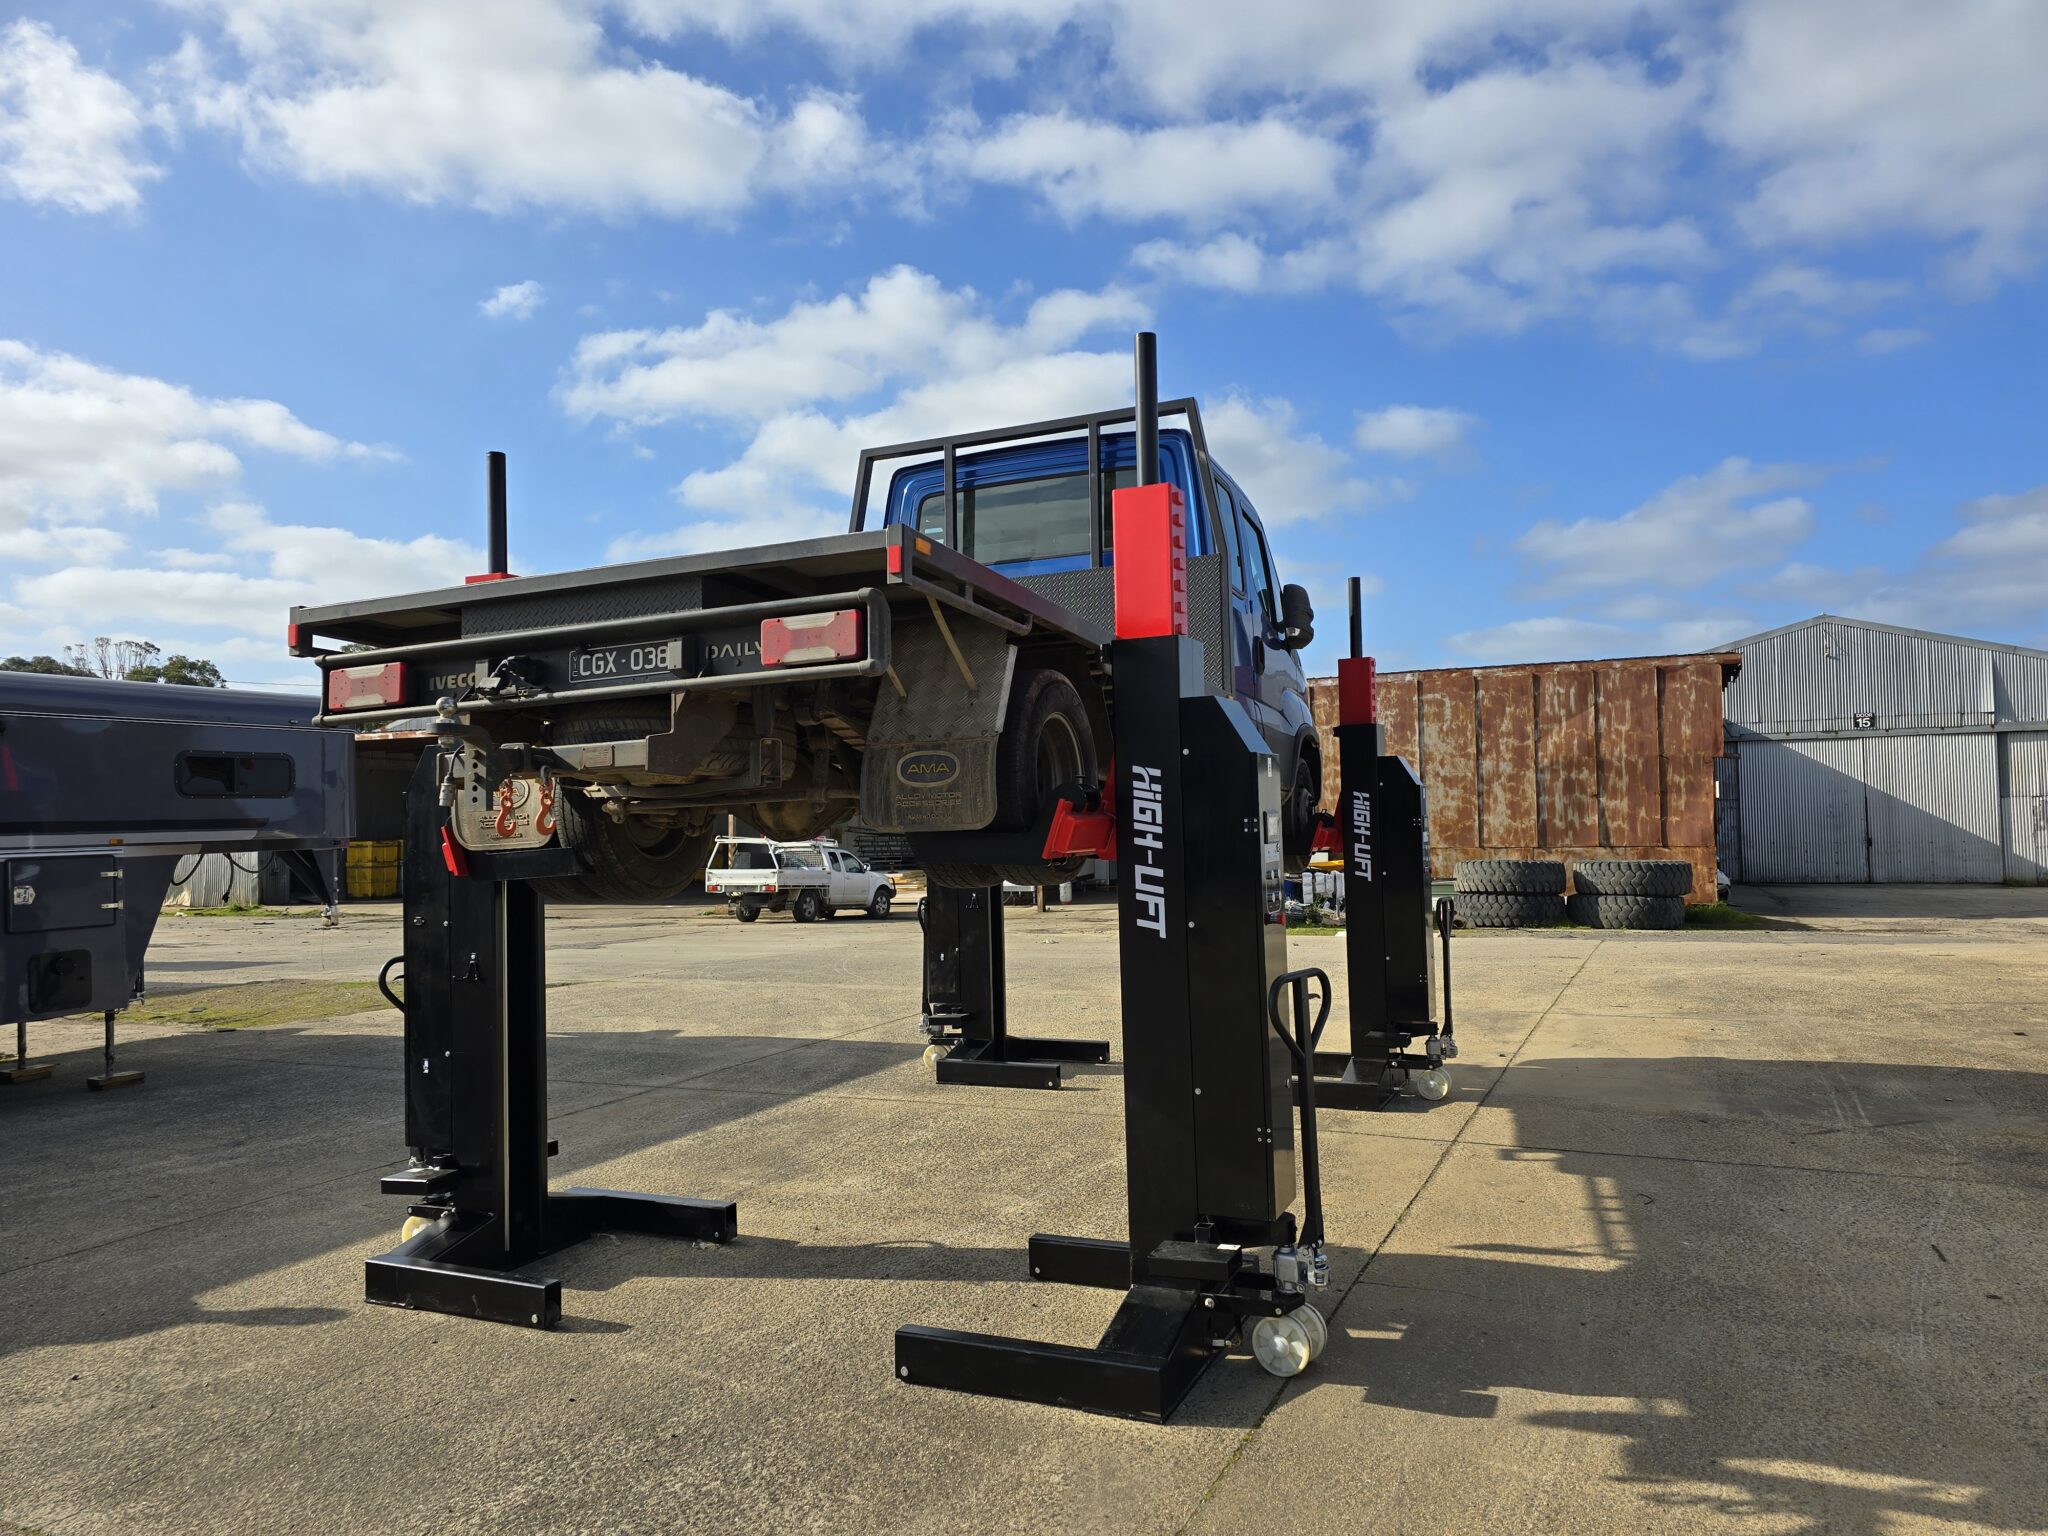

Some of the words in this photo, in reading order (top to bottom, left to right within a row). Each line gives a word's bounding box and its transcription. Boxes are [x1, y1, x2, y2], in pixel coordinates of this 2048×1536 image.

[580, 651, 617, 675] CGX
[630, 645, 668, 671] 038
[1856, 717, 1871, 728] 15
[906, 762, 950, 775] AMA
